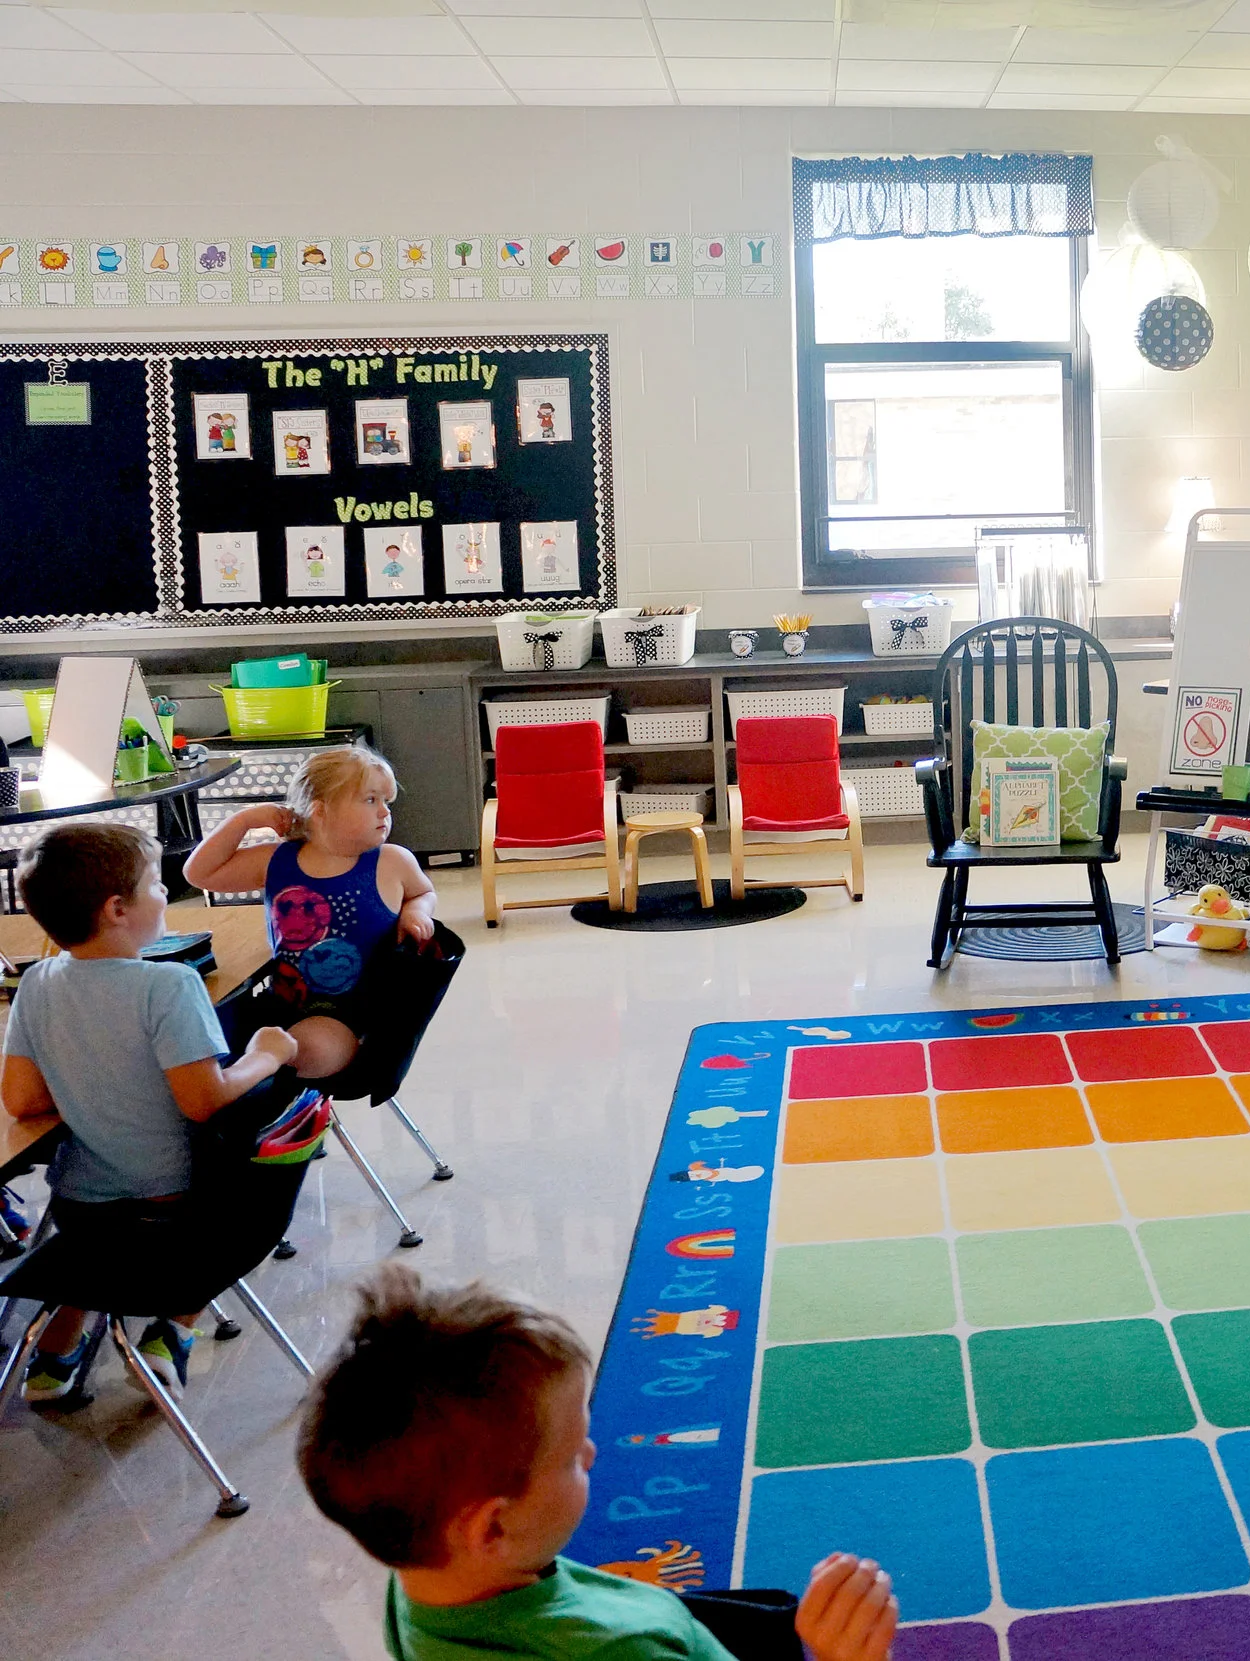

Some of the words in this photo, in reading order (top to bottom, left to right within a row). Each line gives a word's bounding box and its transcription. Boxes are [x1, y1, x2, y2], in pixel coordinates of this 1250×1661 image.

[262, 361, 322, 388] The
[396, 354, 498, 390] Family
[334, 492, 434, 522] Vowels
[1185, 695, 1203, 707] NO
[1181, 758, 1222, 769] zone
